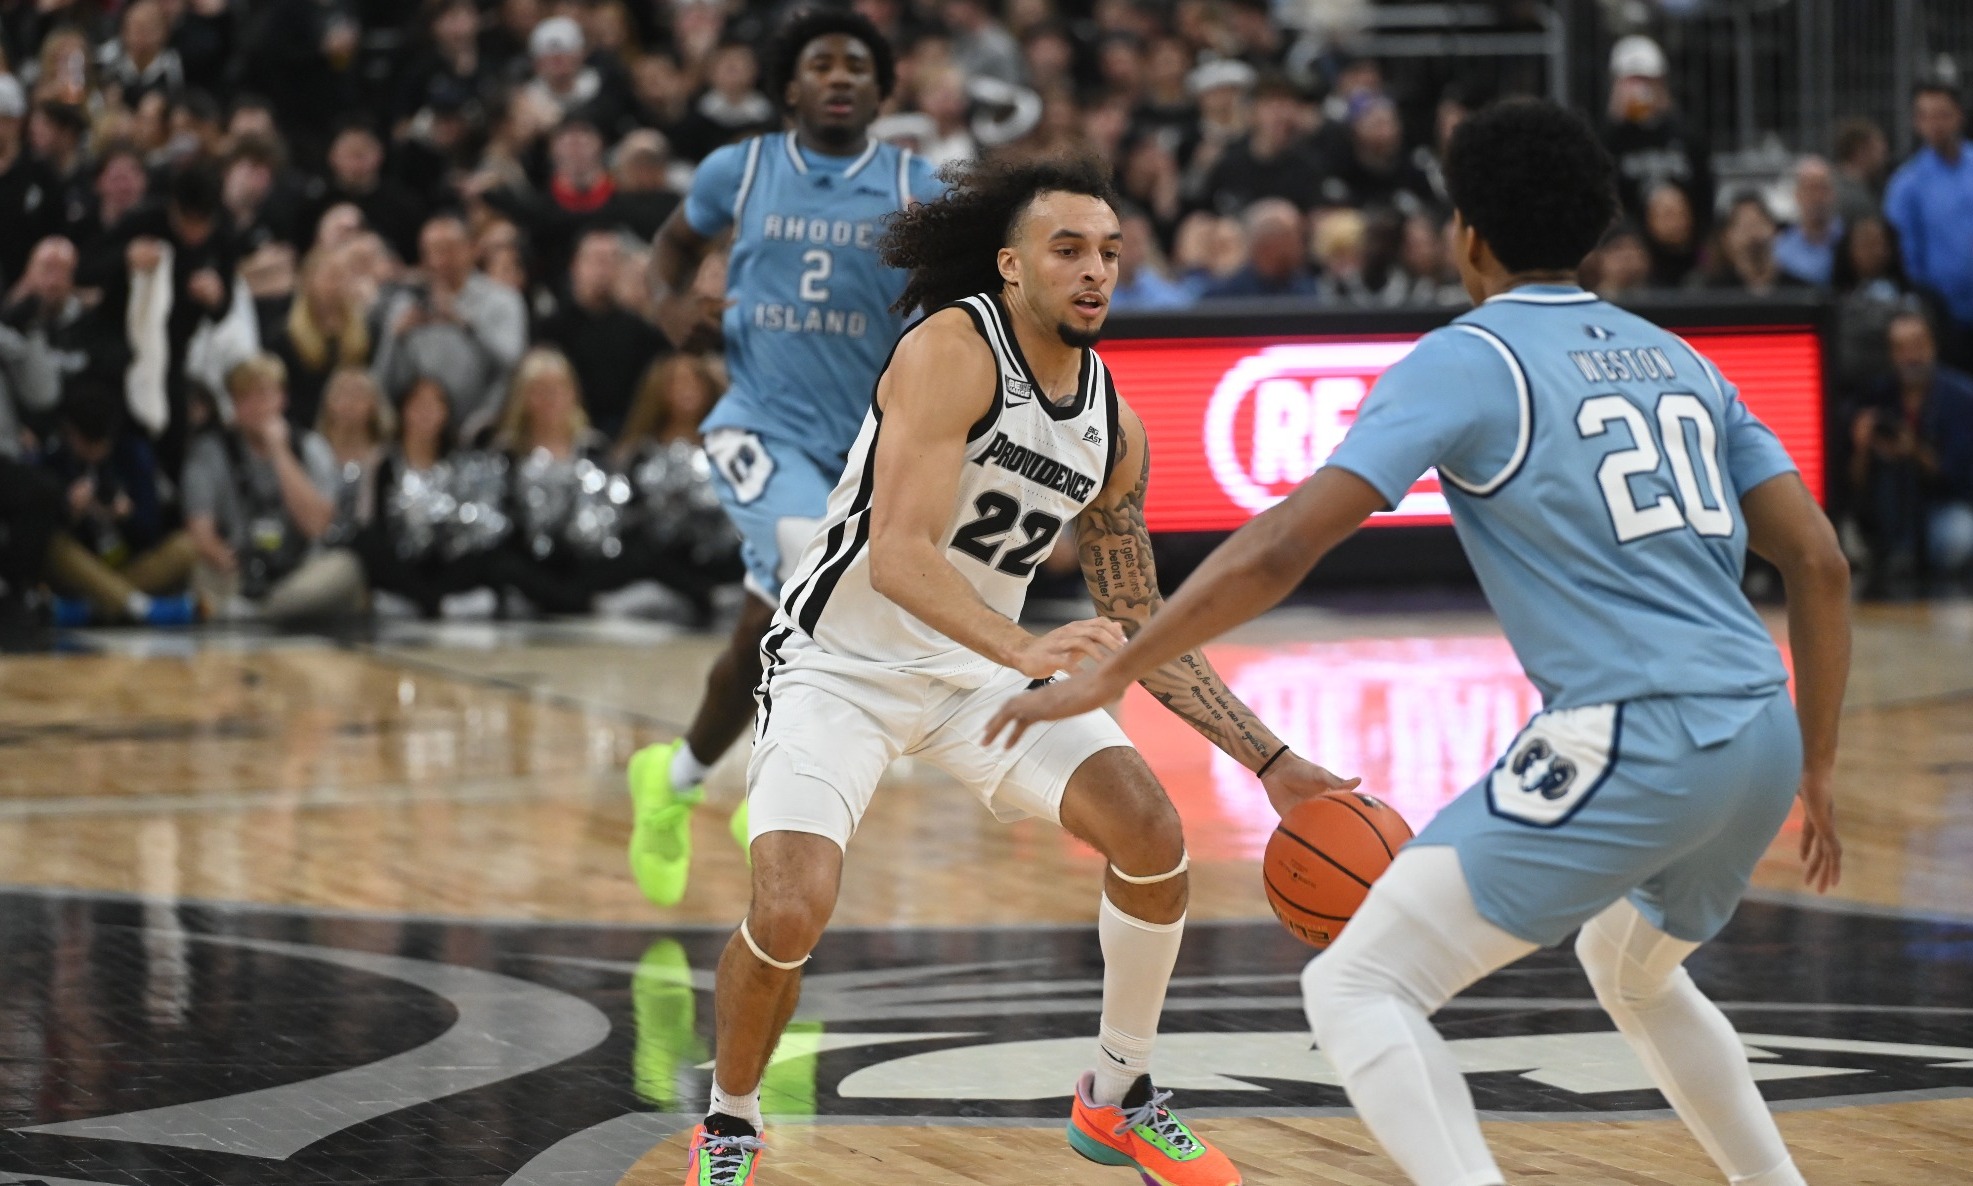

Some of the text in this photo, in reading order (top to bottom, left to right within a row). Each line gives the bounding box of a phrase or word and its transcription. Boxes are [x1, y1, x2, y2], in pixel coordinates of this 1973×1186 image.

[764, 214, 875, 249] RHODE
[801, 249, 832, 302] 2
[755, 303, 867, 337] ISLAND
[1568, 347, 1676, 382] WESTON
[1083, 432, 1102, 444] EAST
[1087, 425, 1099, 436] BIG
[1253, 376, 1367, 486] RE
[971, 431, 1097, 505] PROVIDENCE
[1574, 392, 1735, 545] 20
[948, 488, 1063, 578] 22
[1091, 545, 1110, 598] gets better
[1109, 549, 1122, 580] before
[1120, 547, 1136, 568] gets
[1128, 569, 1141, 598] worse
[1180, 654, 1200, 669] God
[1196, 676, 1210, 686] for
[1208, 687, 1217, 696] us
[1215, 695, 1228, 710] who
[1227, 710, 1239, 722] can
[1236, 721, 1246, 731] be
[1241, 731, 1266, 752] against
[1190, 685, 1212, 709] Romans
